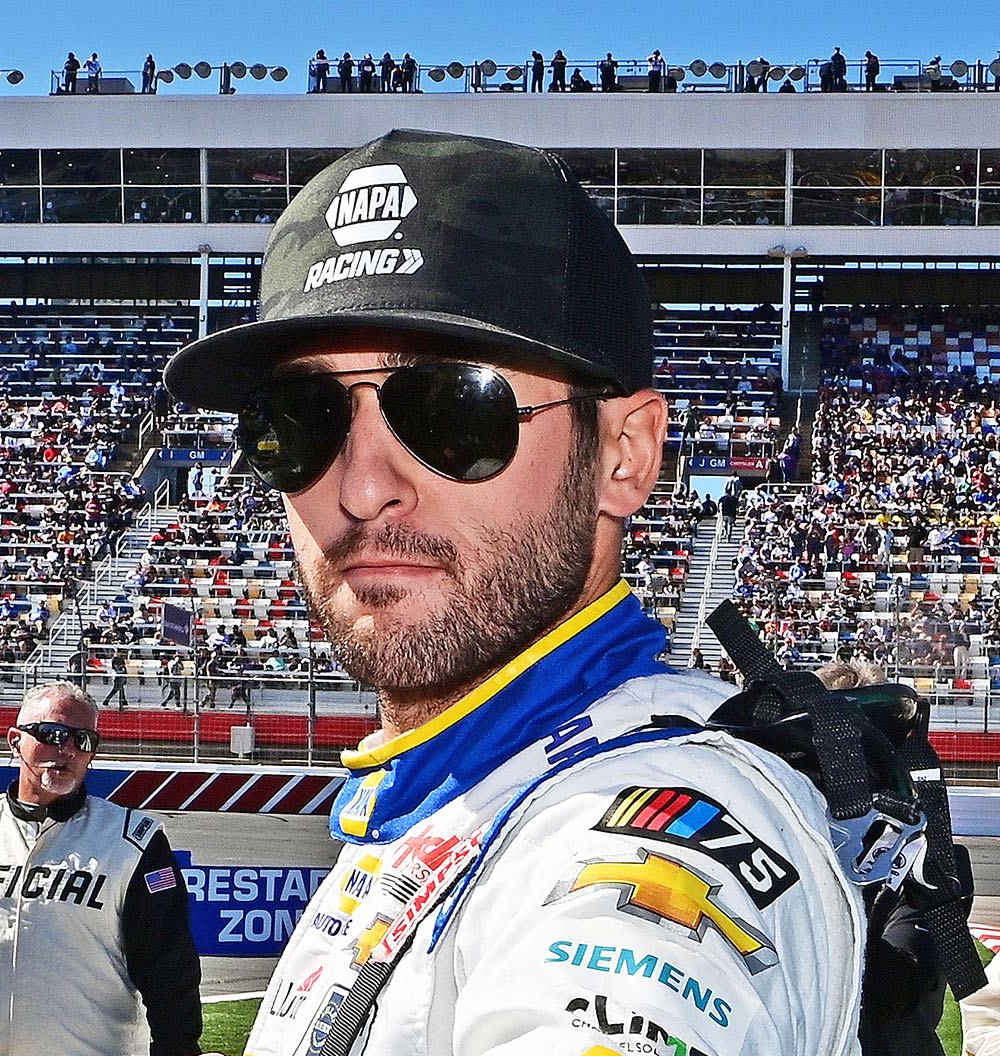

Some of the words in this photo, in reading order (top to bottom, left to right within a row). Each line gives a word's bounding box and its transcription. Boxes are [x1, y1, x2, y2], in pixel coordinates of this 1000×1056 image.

[337, 185, 400, 227] NAPA
[303, 248, 400, 293] RACING
[189, 450, 205, 459] GM
[699, 459, 706, 467] J
[709, 458, 726, 467] GM
[755, 459, 764, 469] A
[698, 814, 787, 893] 75
[544, 940, 732, 1028] SIEMENS
